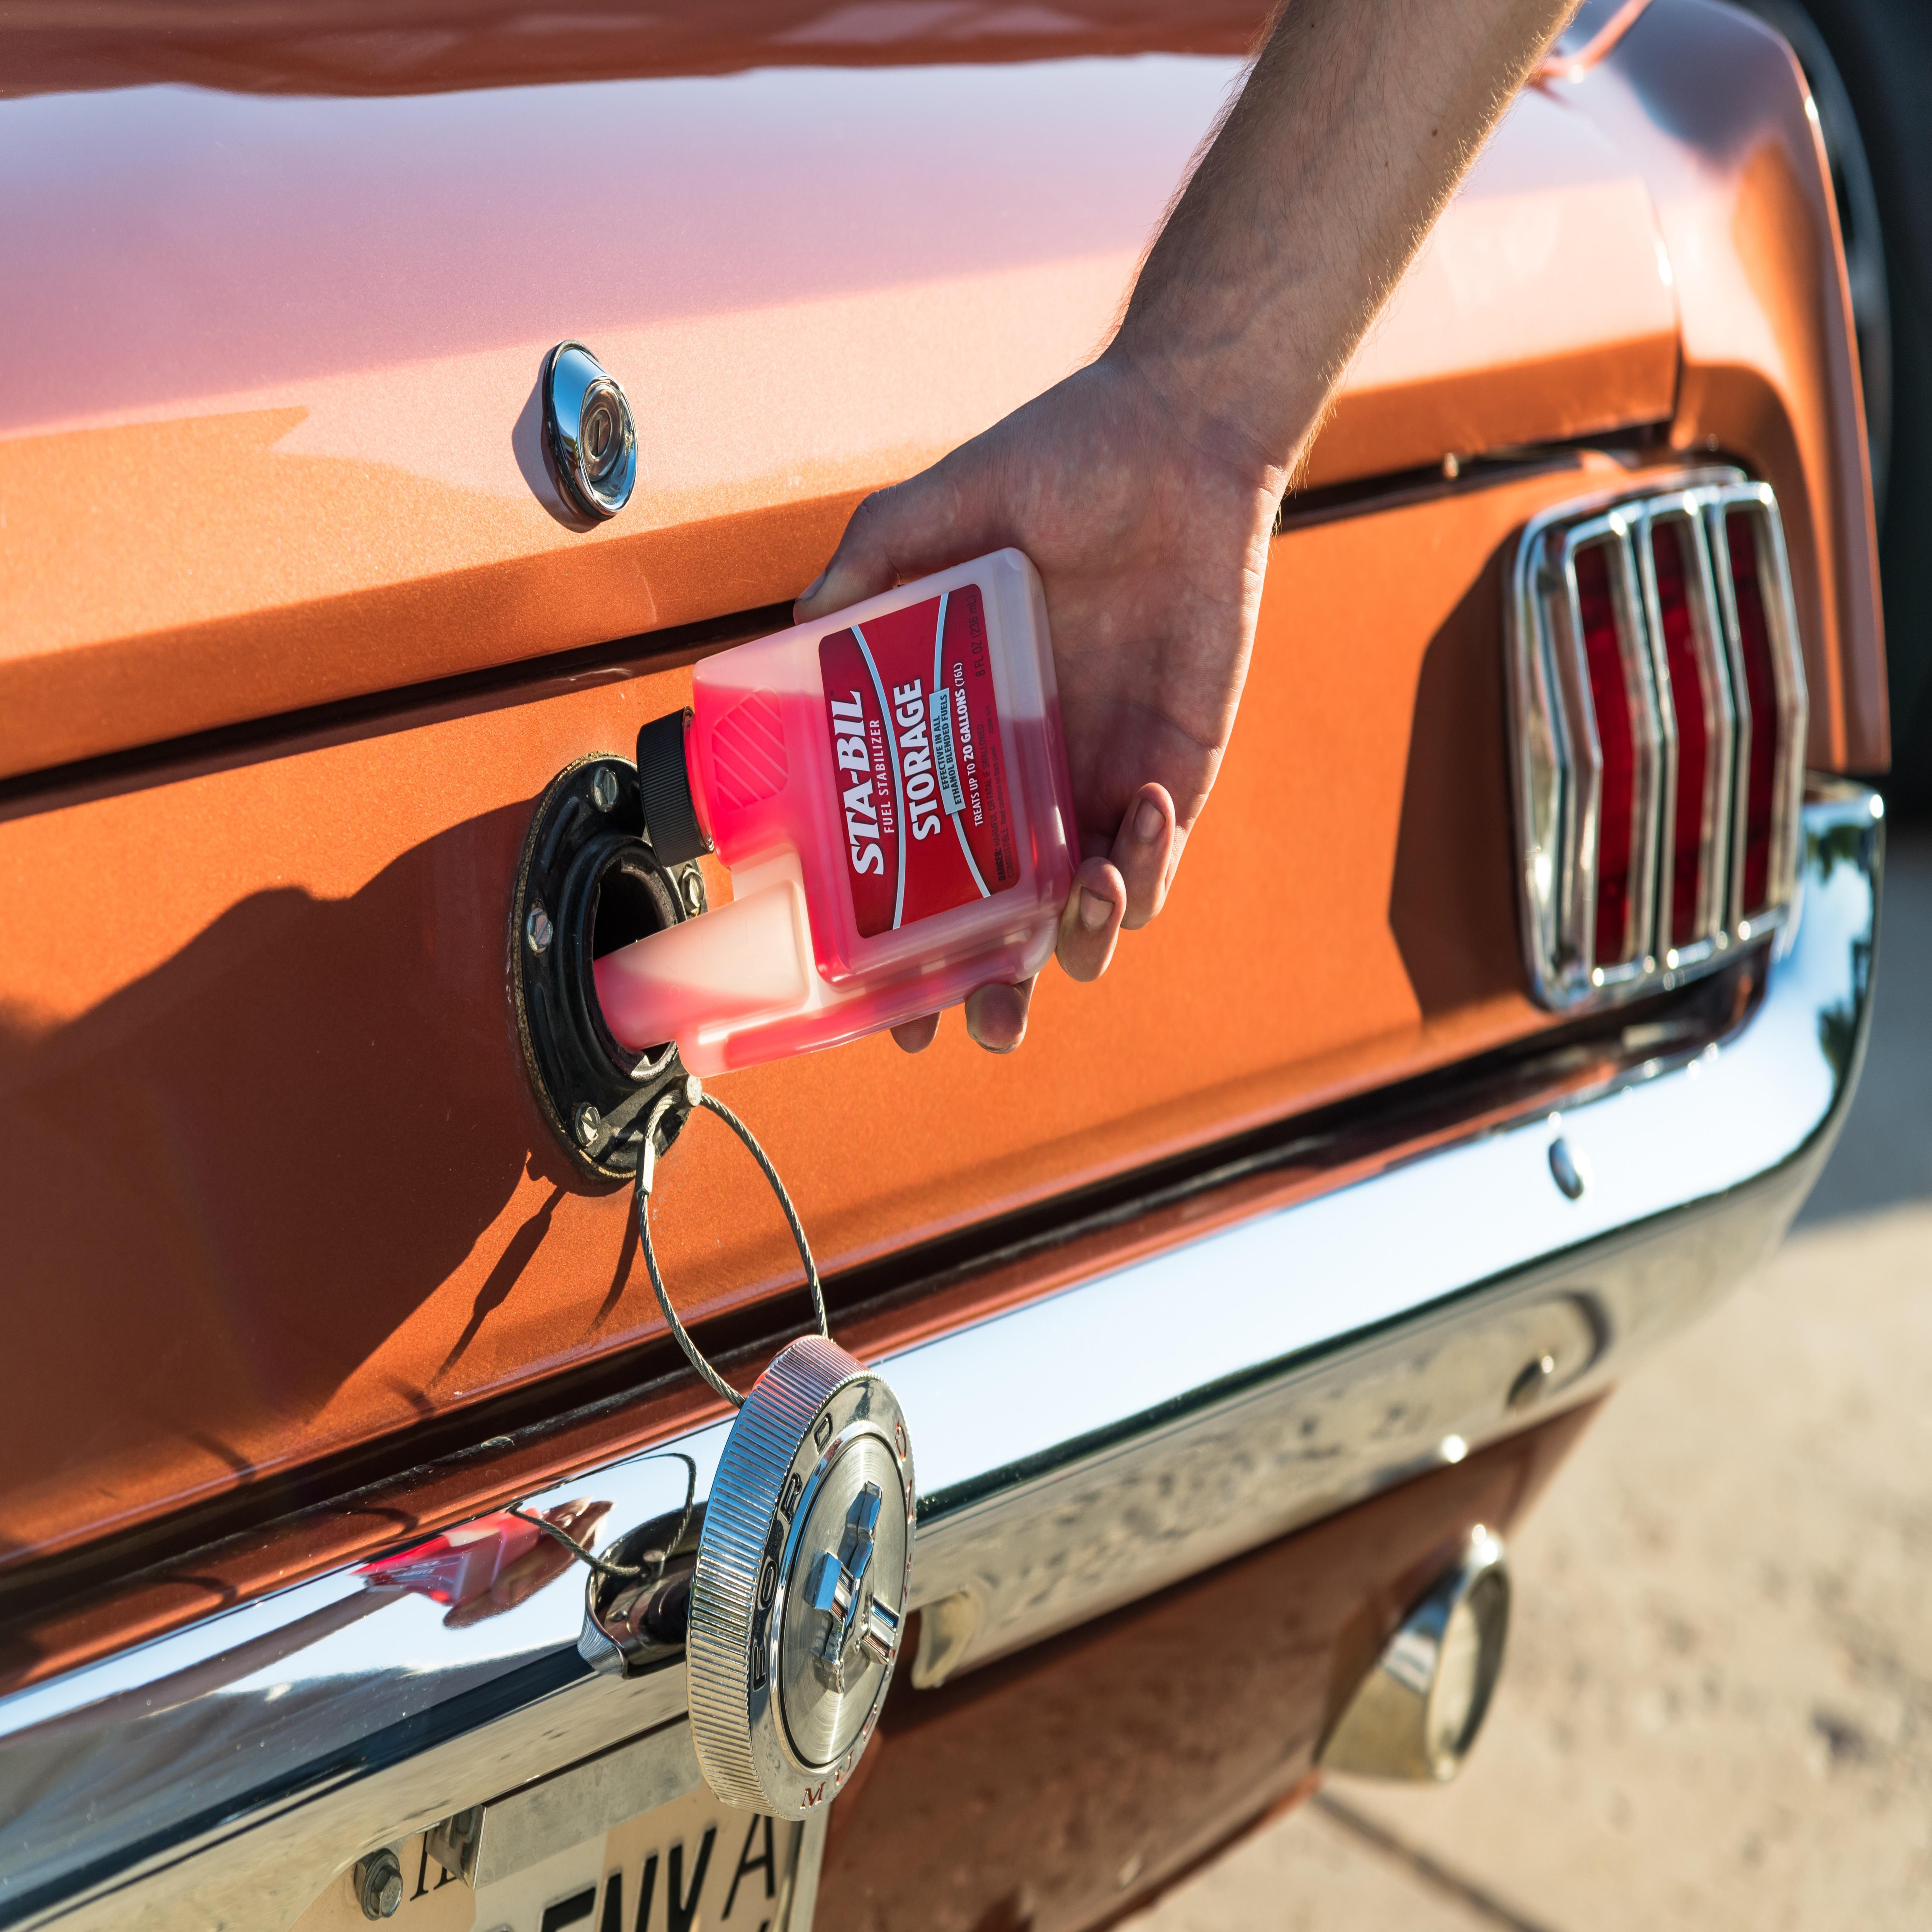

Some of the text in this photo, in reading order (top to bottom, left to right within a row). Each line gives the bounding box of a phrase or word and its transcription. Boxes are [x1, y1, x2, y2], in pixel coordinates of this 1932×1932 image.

[967, 594, 977, 614] mL)
[969, 616, 983, 638] (236
[972, 640, 983, 654] OZ
[974, 656, 984, 668] FL
[893, 679, 941, 840] STORAGE
[933, 715, 950, 790] EFFECTIVE IN ALL
[940, 694, 962, 805] ETHANOL BLENDED FUELS
[953, 662, 983, 827] TREATS UP TO 20 GALLONS (76L)
[831, 690, 884, 875] STA-BIL
[869, 719, 895, 833] FUEL STABILIZER
[985, 778, 993, 799] FATAL
[988, 799, 996, 811] OR
[990, 812, 1000, 847] HARMFUL
[994, 847, 1006, 882] DANGER:
[753, 1412, 833, 1691] FORD
